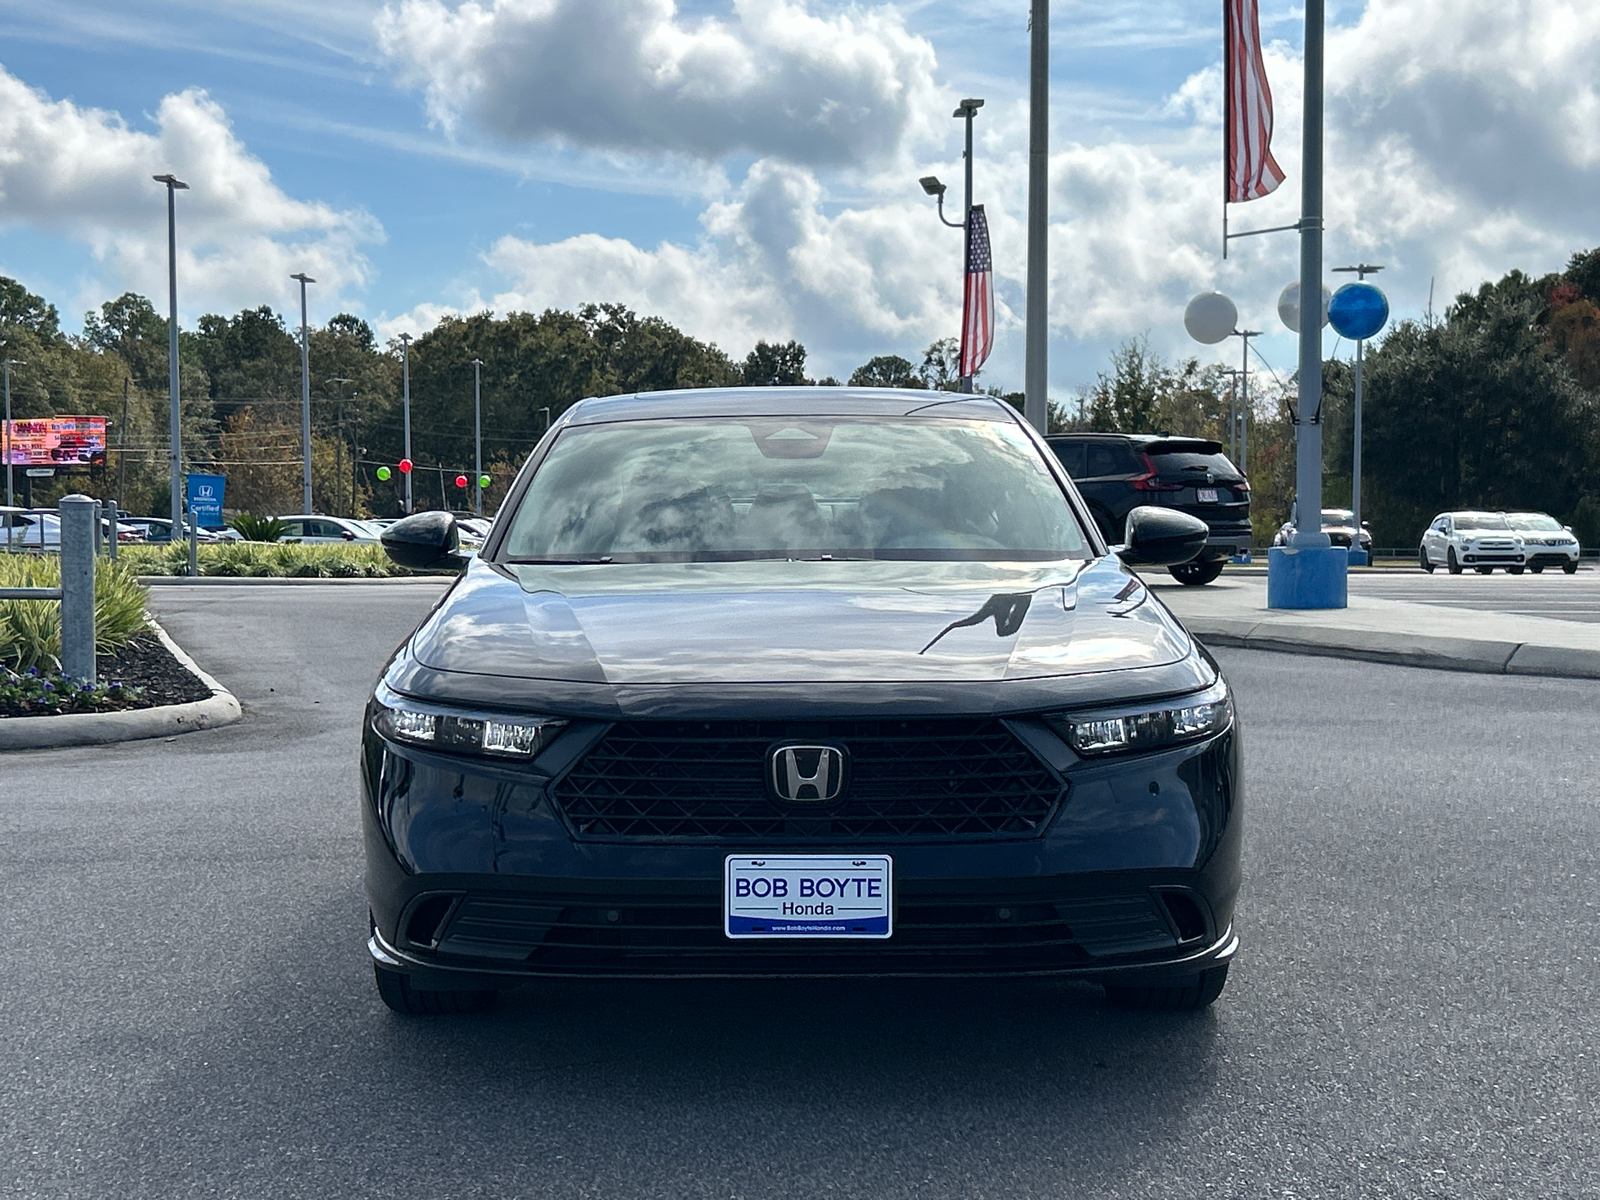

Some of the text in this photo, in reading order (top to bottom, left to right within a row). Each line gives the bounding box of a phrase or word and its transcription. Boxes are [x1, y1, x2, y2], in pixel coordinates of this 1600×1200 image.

[190, 504, 220, 512] Certified
[735, 878, 882, 898] BOB BOYTE
[782, 902, 834, 915] Honda
